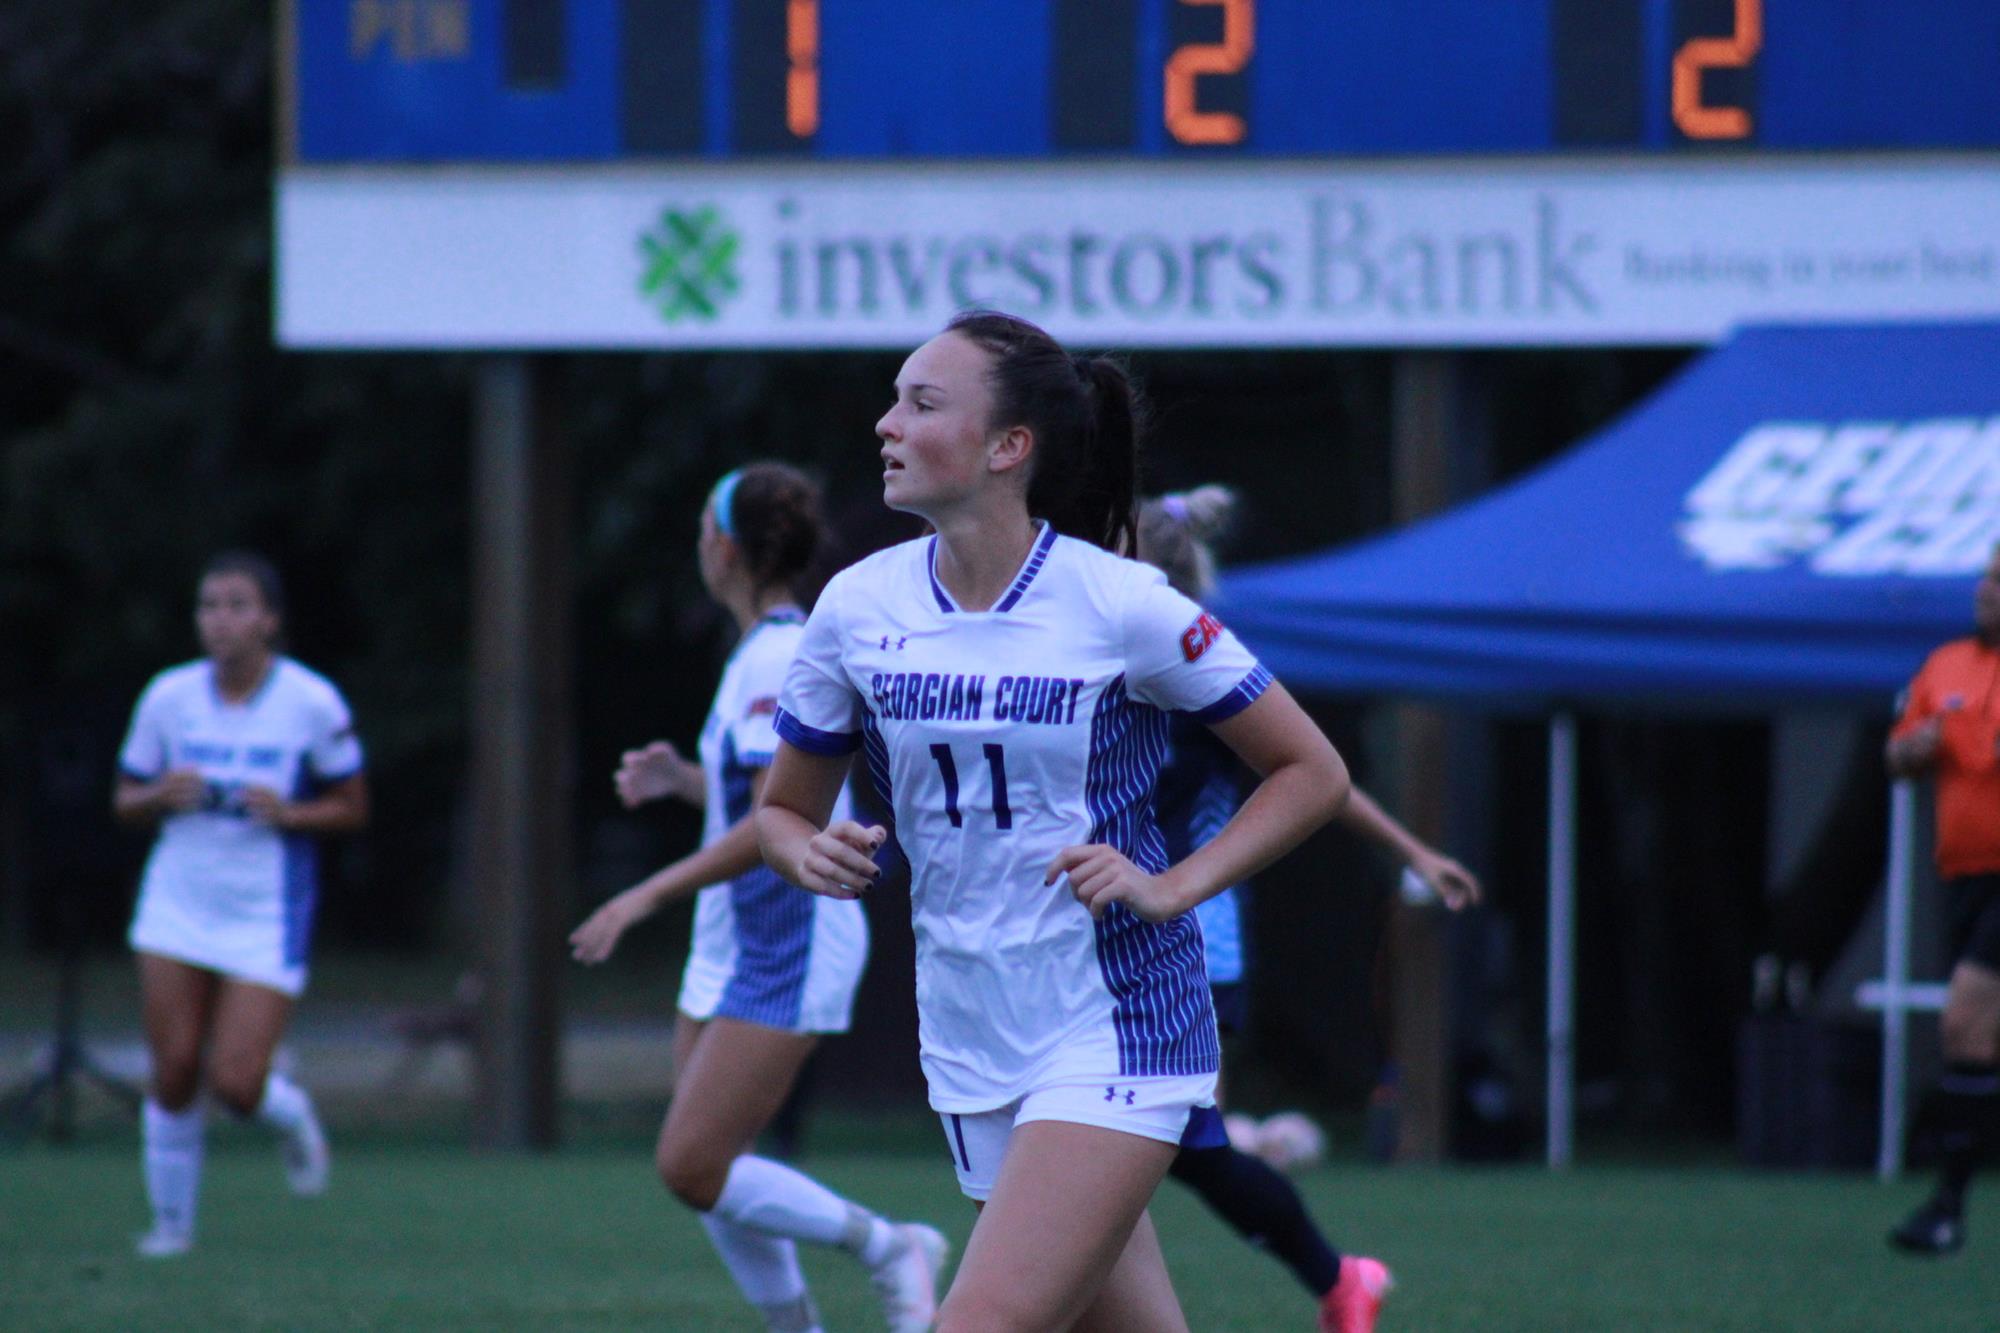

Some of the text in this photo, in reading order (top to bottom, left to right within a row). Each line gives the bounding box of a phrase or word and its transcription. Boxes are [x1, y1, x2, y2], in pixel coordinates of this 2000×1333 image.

[786, 0, 817, 137] 1
[1164, 0, 1254, 145] 2
[1672, 0, 1762, 140] 2
[872, 672, 1085, 725] GEORGIAN COURT
[929, 743, 1013, 830] 11
